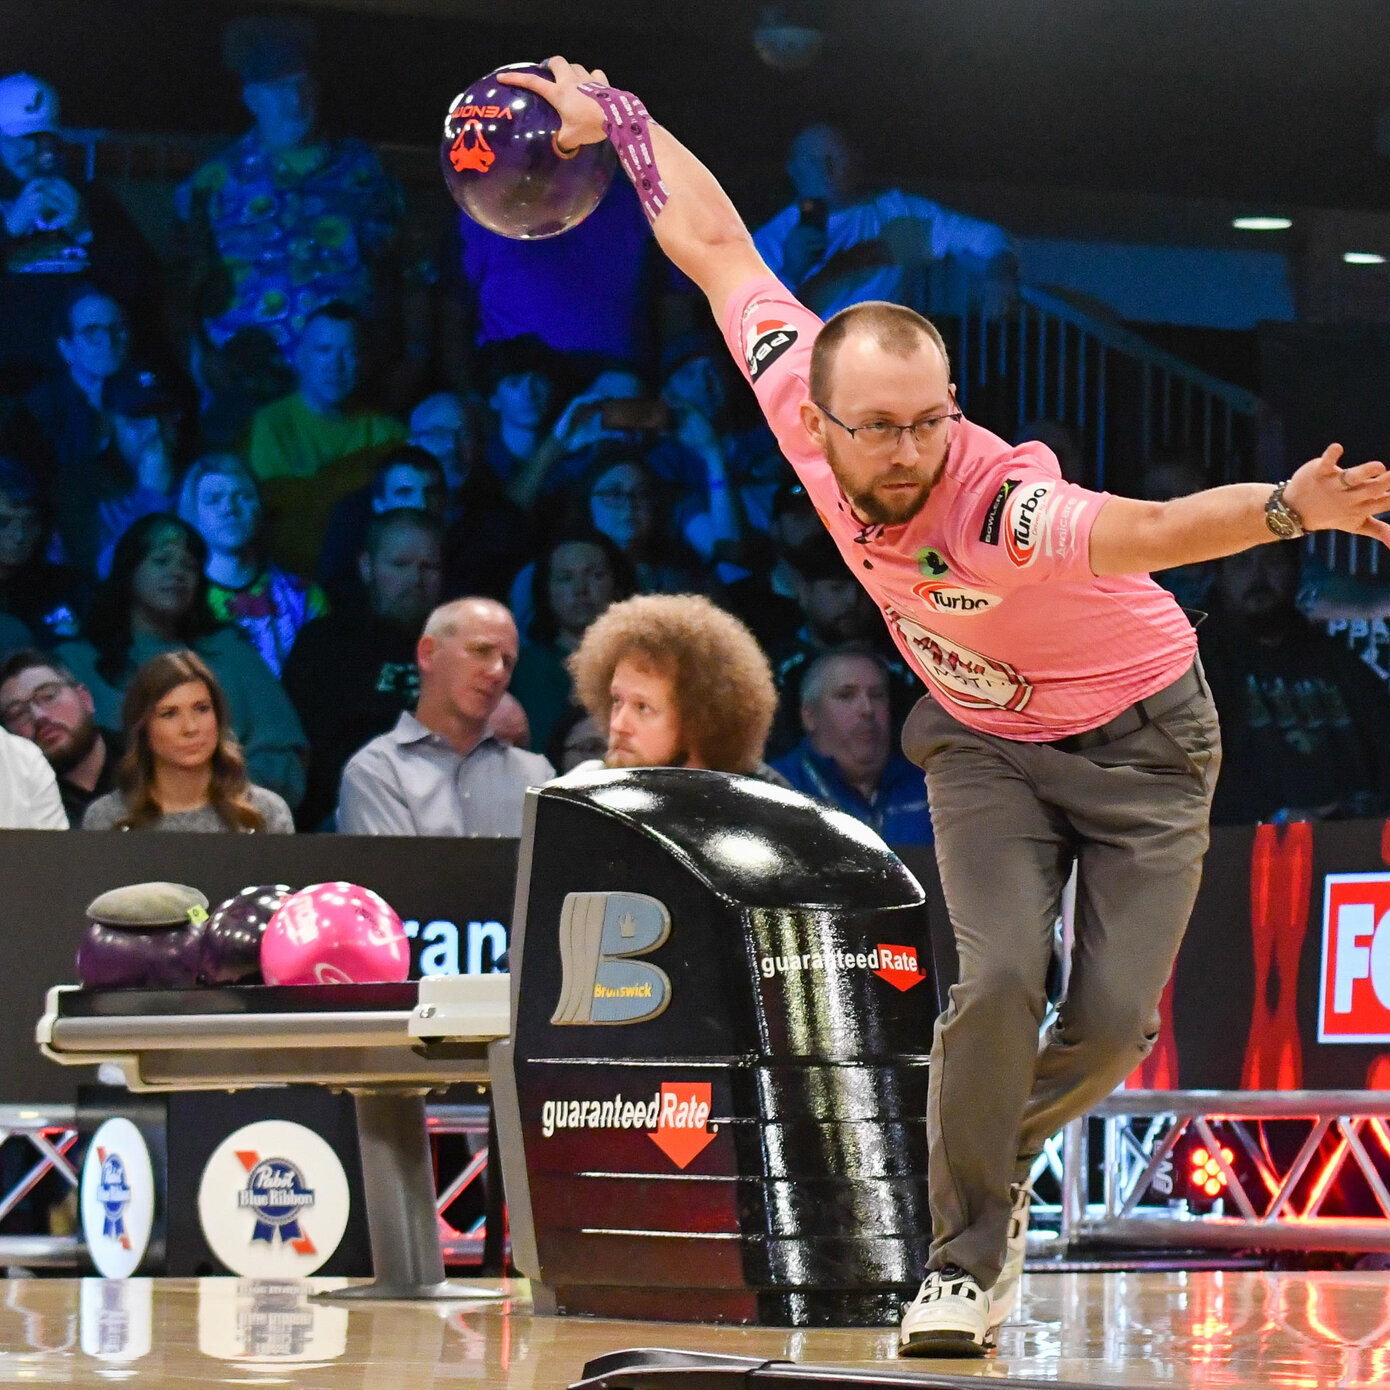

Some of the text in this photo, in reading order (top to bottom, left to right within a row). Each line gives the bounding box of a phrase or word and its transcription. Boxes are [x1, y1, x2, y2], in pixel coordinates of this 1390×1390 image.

[1014, 488, 1048, 546] Turbo
[929, 590, 989, 612] Turbo
[594, 982, 652, 998] Brunswick
[256, 1165, 296, 1190] Pabst
